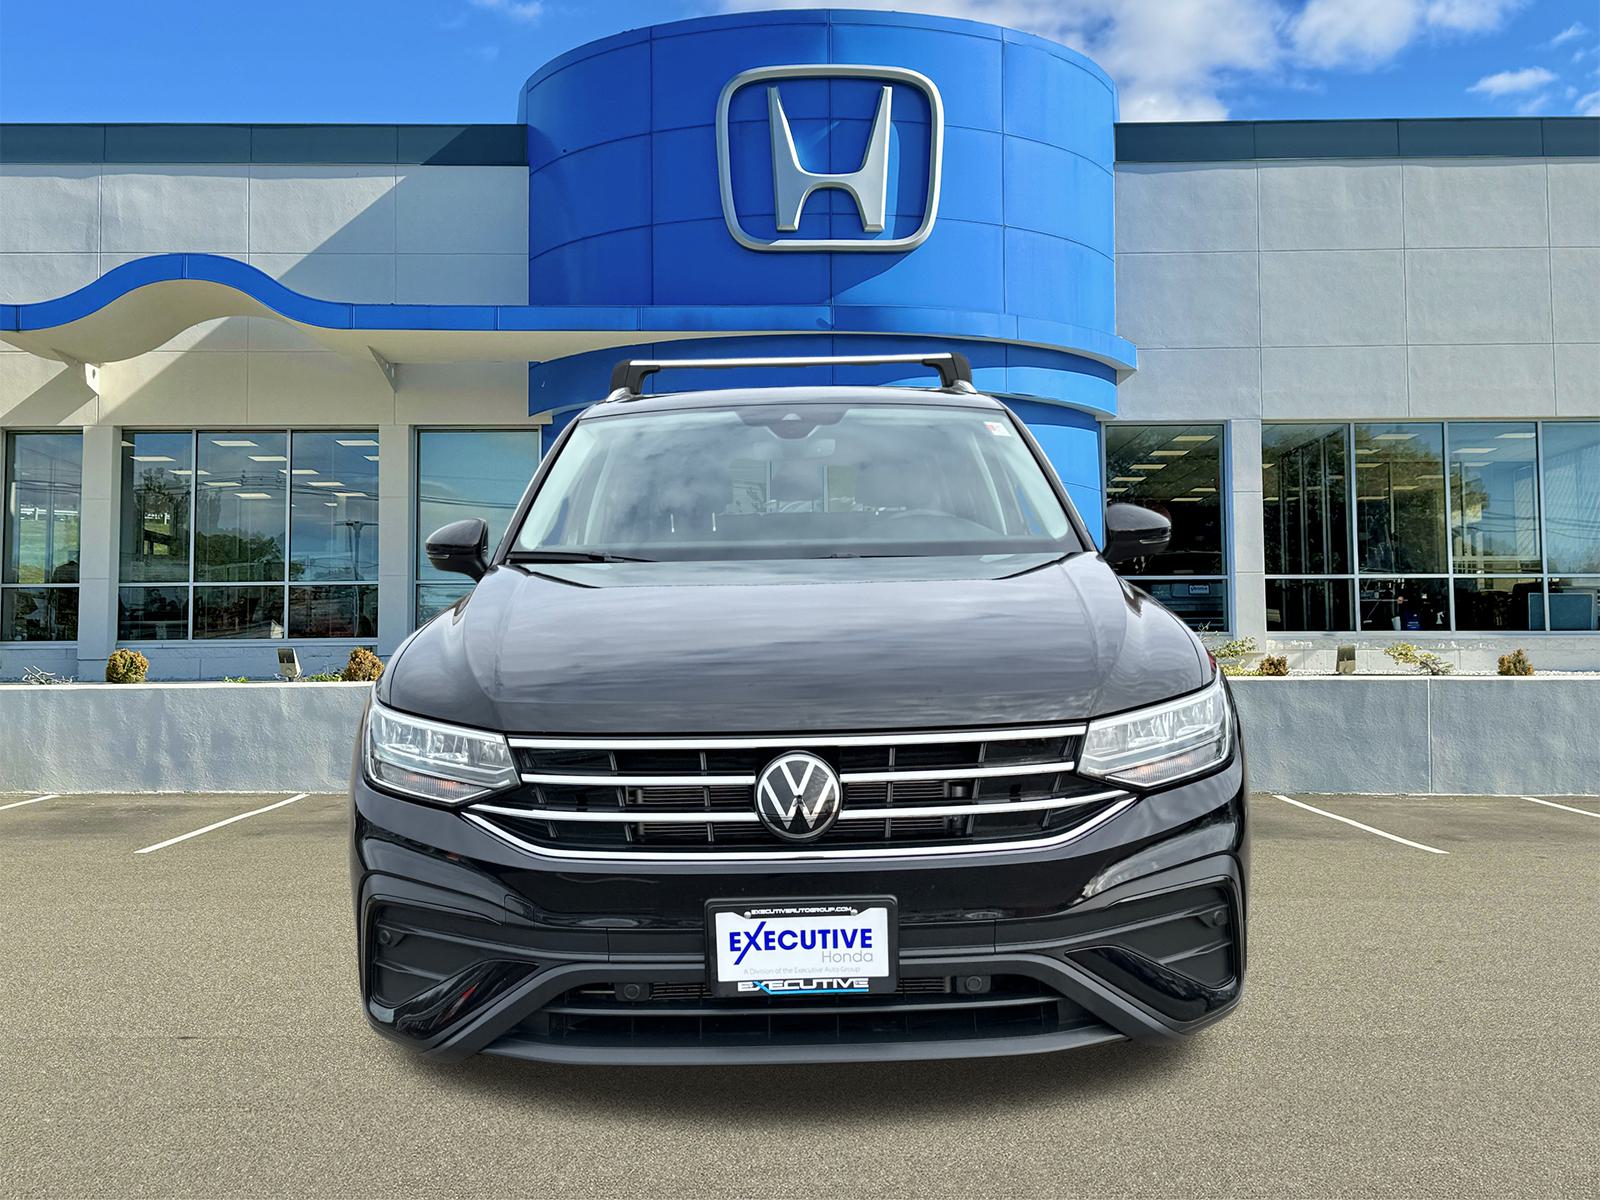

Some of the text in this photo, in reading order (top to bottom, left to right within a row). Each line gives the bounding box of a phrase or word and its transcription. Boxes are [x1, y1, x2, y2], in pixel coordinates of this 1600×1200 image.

[729, 921, 873, 966] EXECUTIVE
[821, 950, 874, 964] Honda
[743, 967, 749, 975] A
[749, 967, 774, 975] Division
[775, 966, 782, 974] of
[793, 965, 823, 974] Executive
[824, 965, 839, 973] Auto
[840, 964, 861, 973] Group
[737, 978, 870, 993] EXECUTIVE
